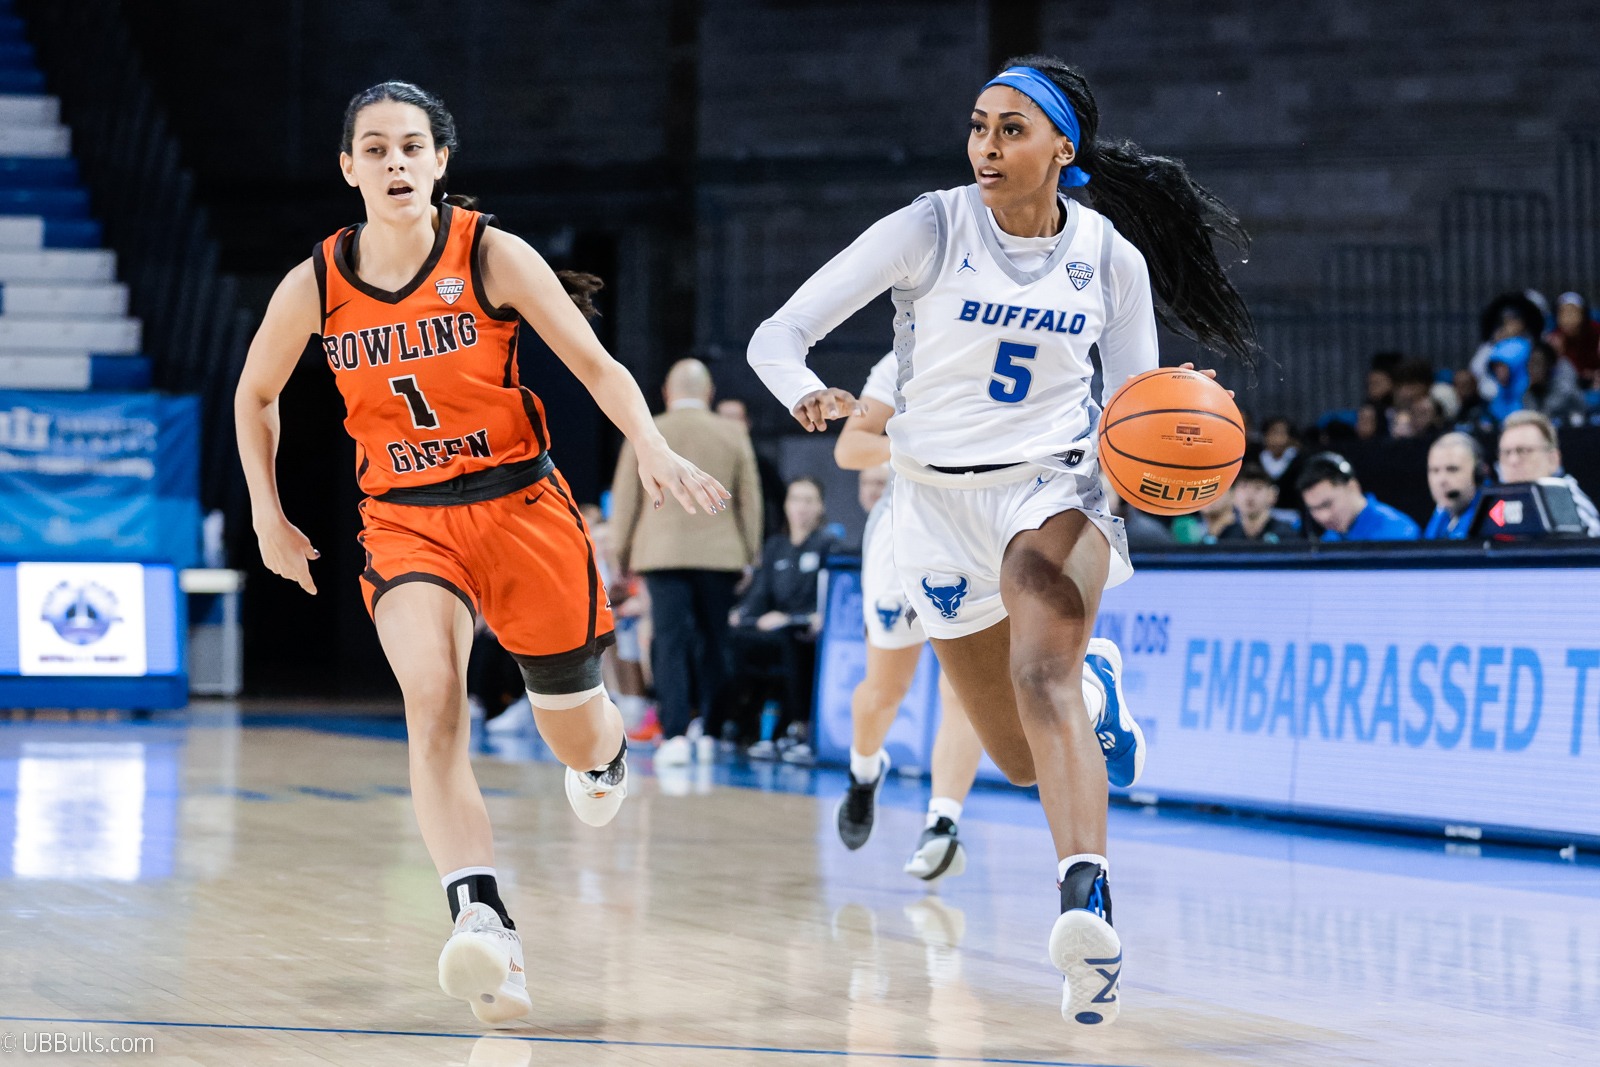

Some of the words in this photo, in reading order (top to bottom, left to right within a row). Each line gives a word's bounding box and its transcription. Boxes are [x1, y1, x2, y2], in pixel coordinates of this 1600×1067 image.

[437, 285, 463, 295] MAC
[1069, 268, 1093, 280] MAC
[956, 299, 1087, 336] BUFFALO
[323, 312, 478, 371] BOWLING
[986, 338, 1040, 404] 5
[388, 374, 440, 430] 1
[1139, 478, 1220, 501] ELITE
[1180, 637, 1543, 752] EMBARRASSED
[1566, 648, 1600, 756] T
